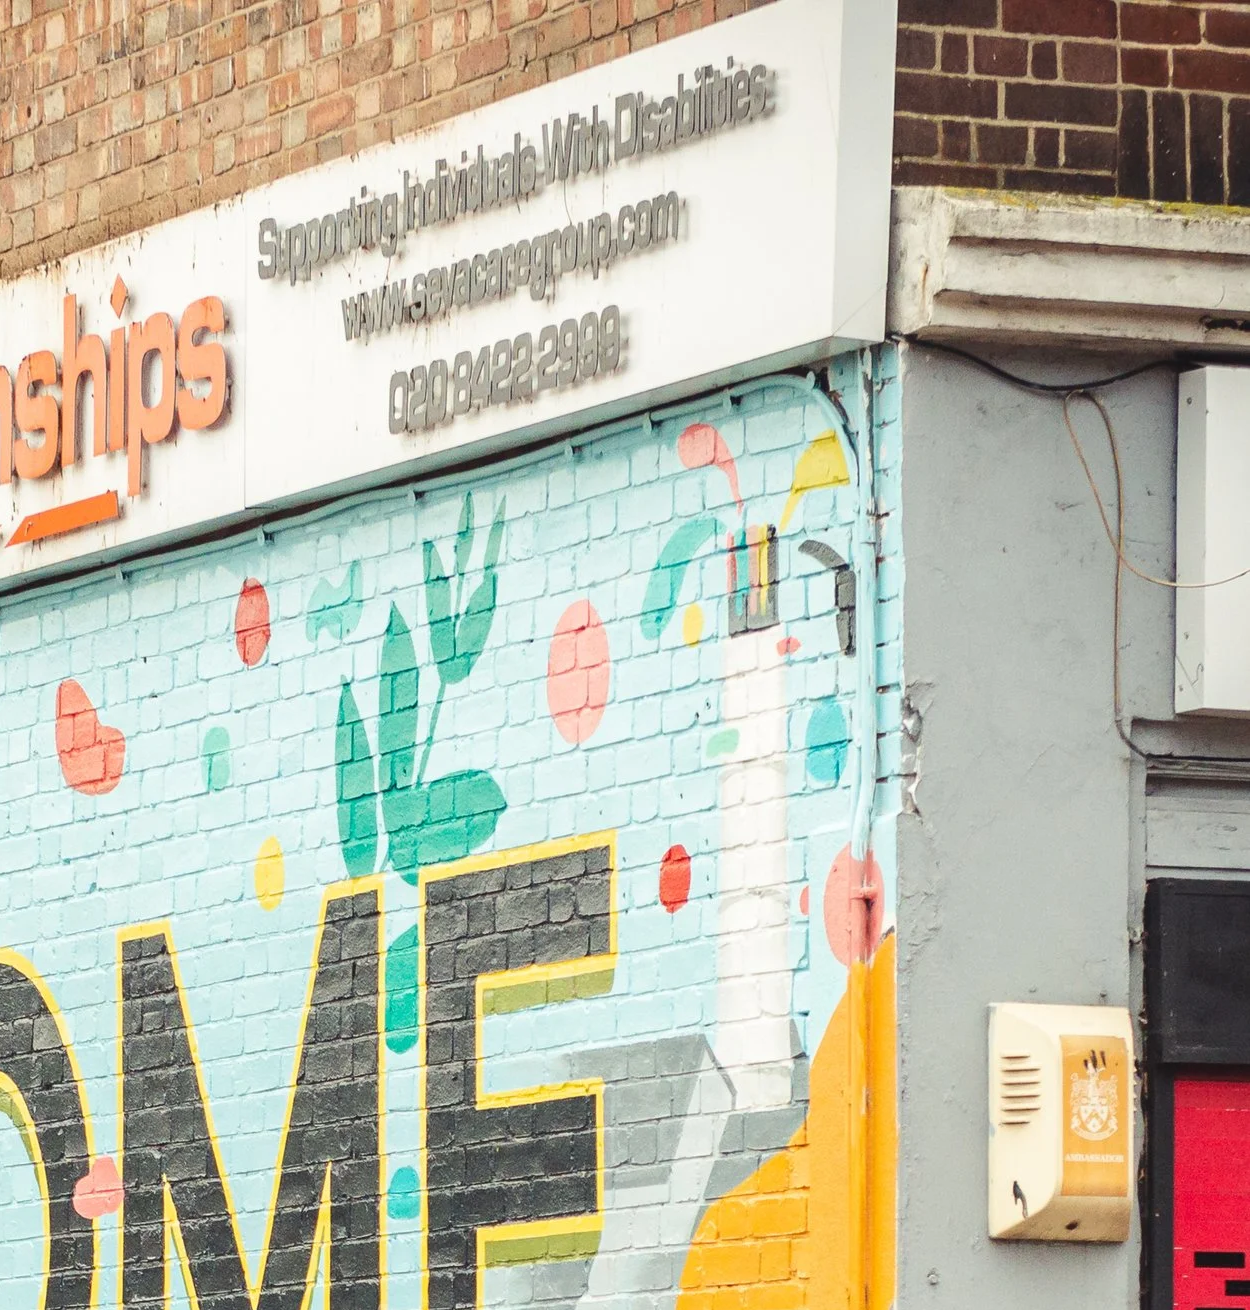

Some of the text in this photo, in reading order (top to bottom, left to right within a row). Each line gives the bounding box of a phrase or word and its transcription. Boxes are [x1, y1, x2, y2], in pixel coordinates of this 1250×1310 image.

[258, 56, 766, 286] Supporting Individuals With Disabilities
[341, 191, 679, 341] www.sevacaregroup.com
[389, 359, 448, 434] 020
[453, 332, 533, 415] 8422
